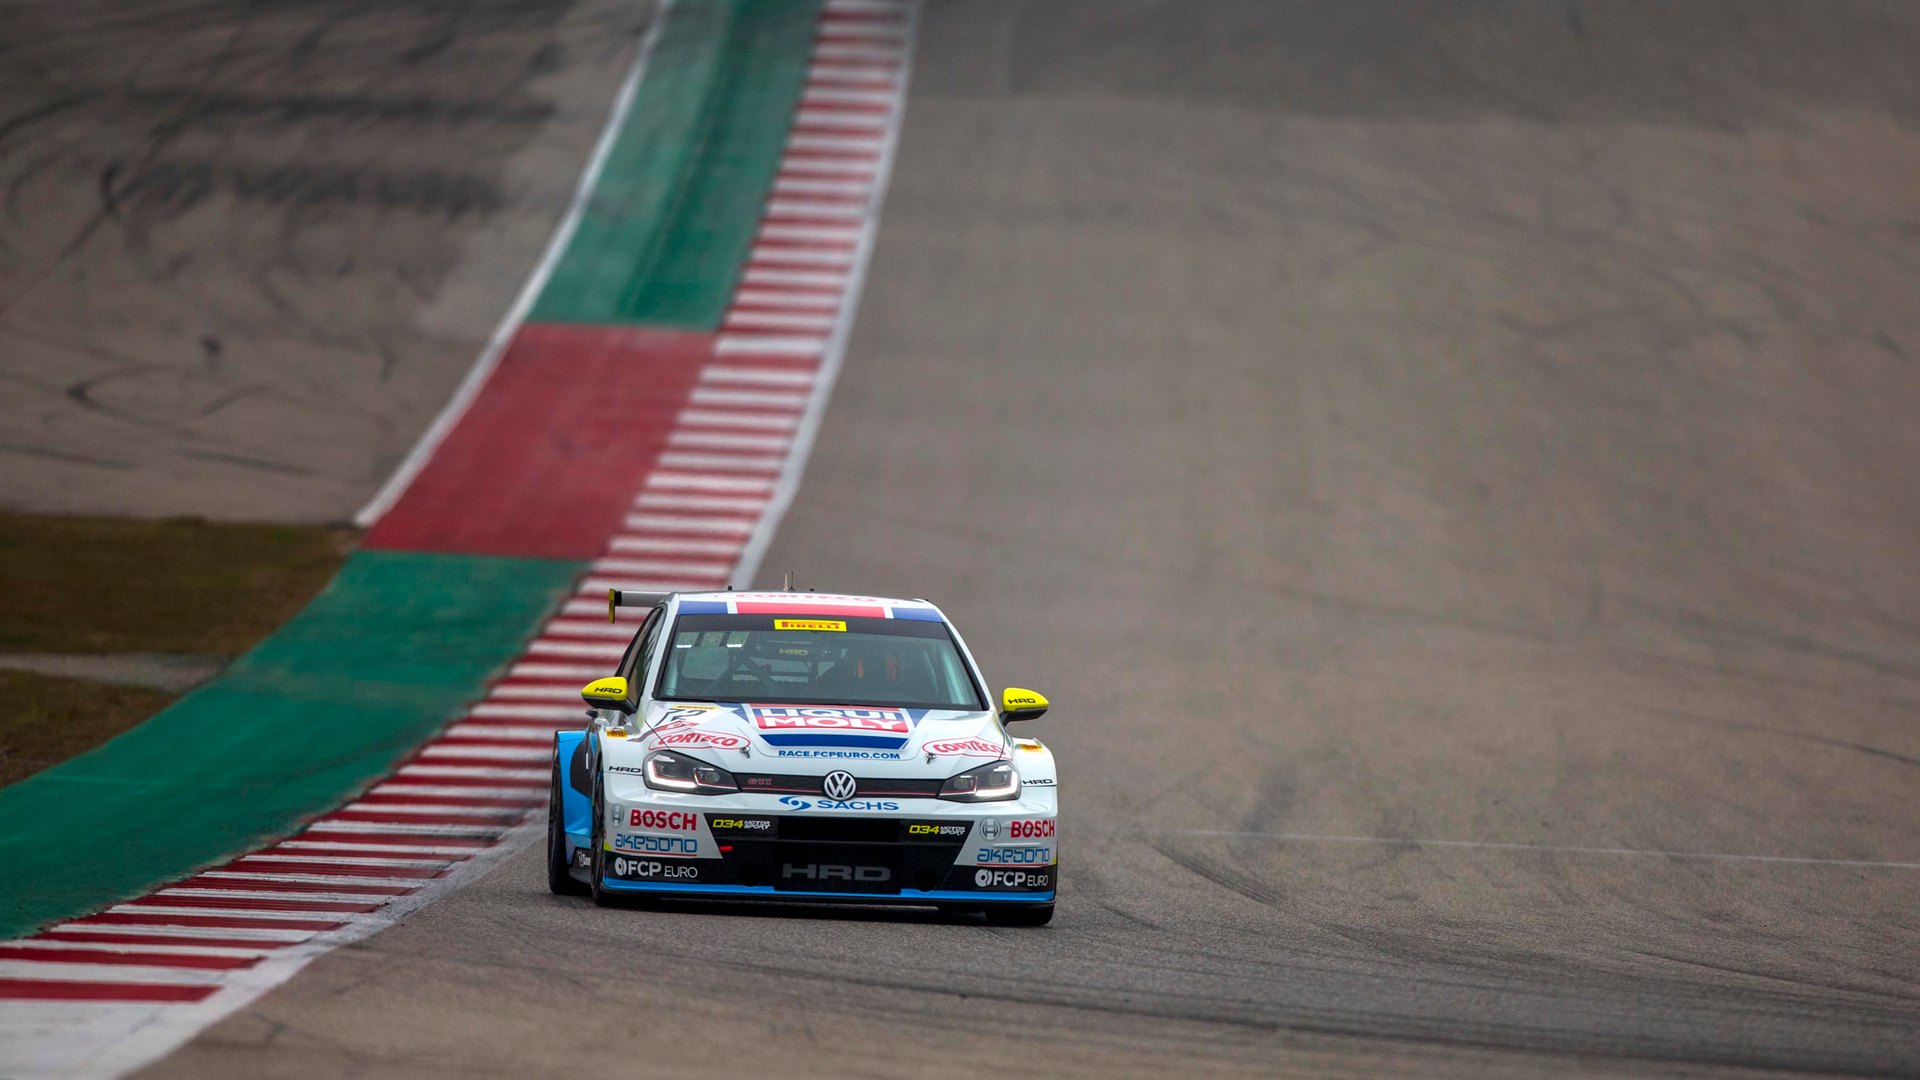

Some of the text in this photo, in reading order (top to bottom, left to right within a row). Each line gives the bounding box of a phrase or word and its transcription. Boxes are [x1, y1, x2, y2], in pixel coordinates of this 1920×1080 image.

[781, 621, 840, 630] PIRELLI
[779, 648, 809, 656] HRD
[594, 686, 623, 694] HRD
[759, 708, 899, 720] LIQUI
[763, 716, 901, 730] MOLY
[658, 732, 739, 746] CORTECO
[933, 740, 1006, 755] CORTECO
[778, 750, 901, 760] RACE.FCPEURO.COM
[817, 800, 899, 811] SACHS
[630, 808, 697, 831] BOSCH
[712, 819, 744, 829] 034
[909, 825, 939, 834] 034
[1010, 819, 1056, 838] BOSCH
[628, 860, 698, 878] FCP EURO
[782, 863, 891, 882] HRD
[993, 871, 1049, 887] FCP EURO
